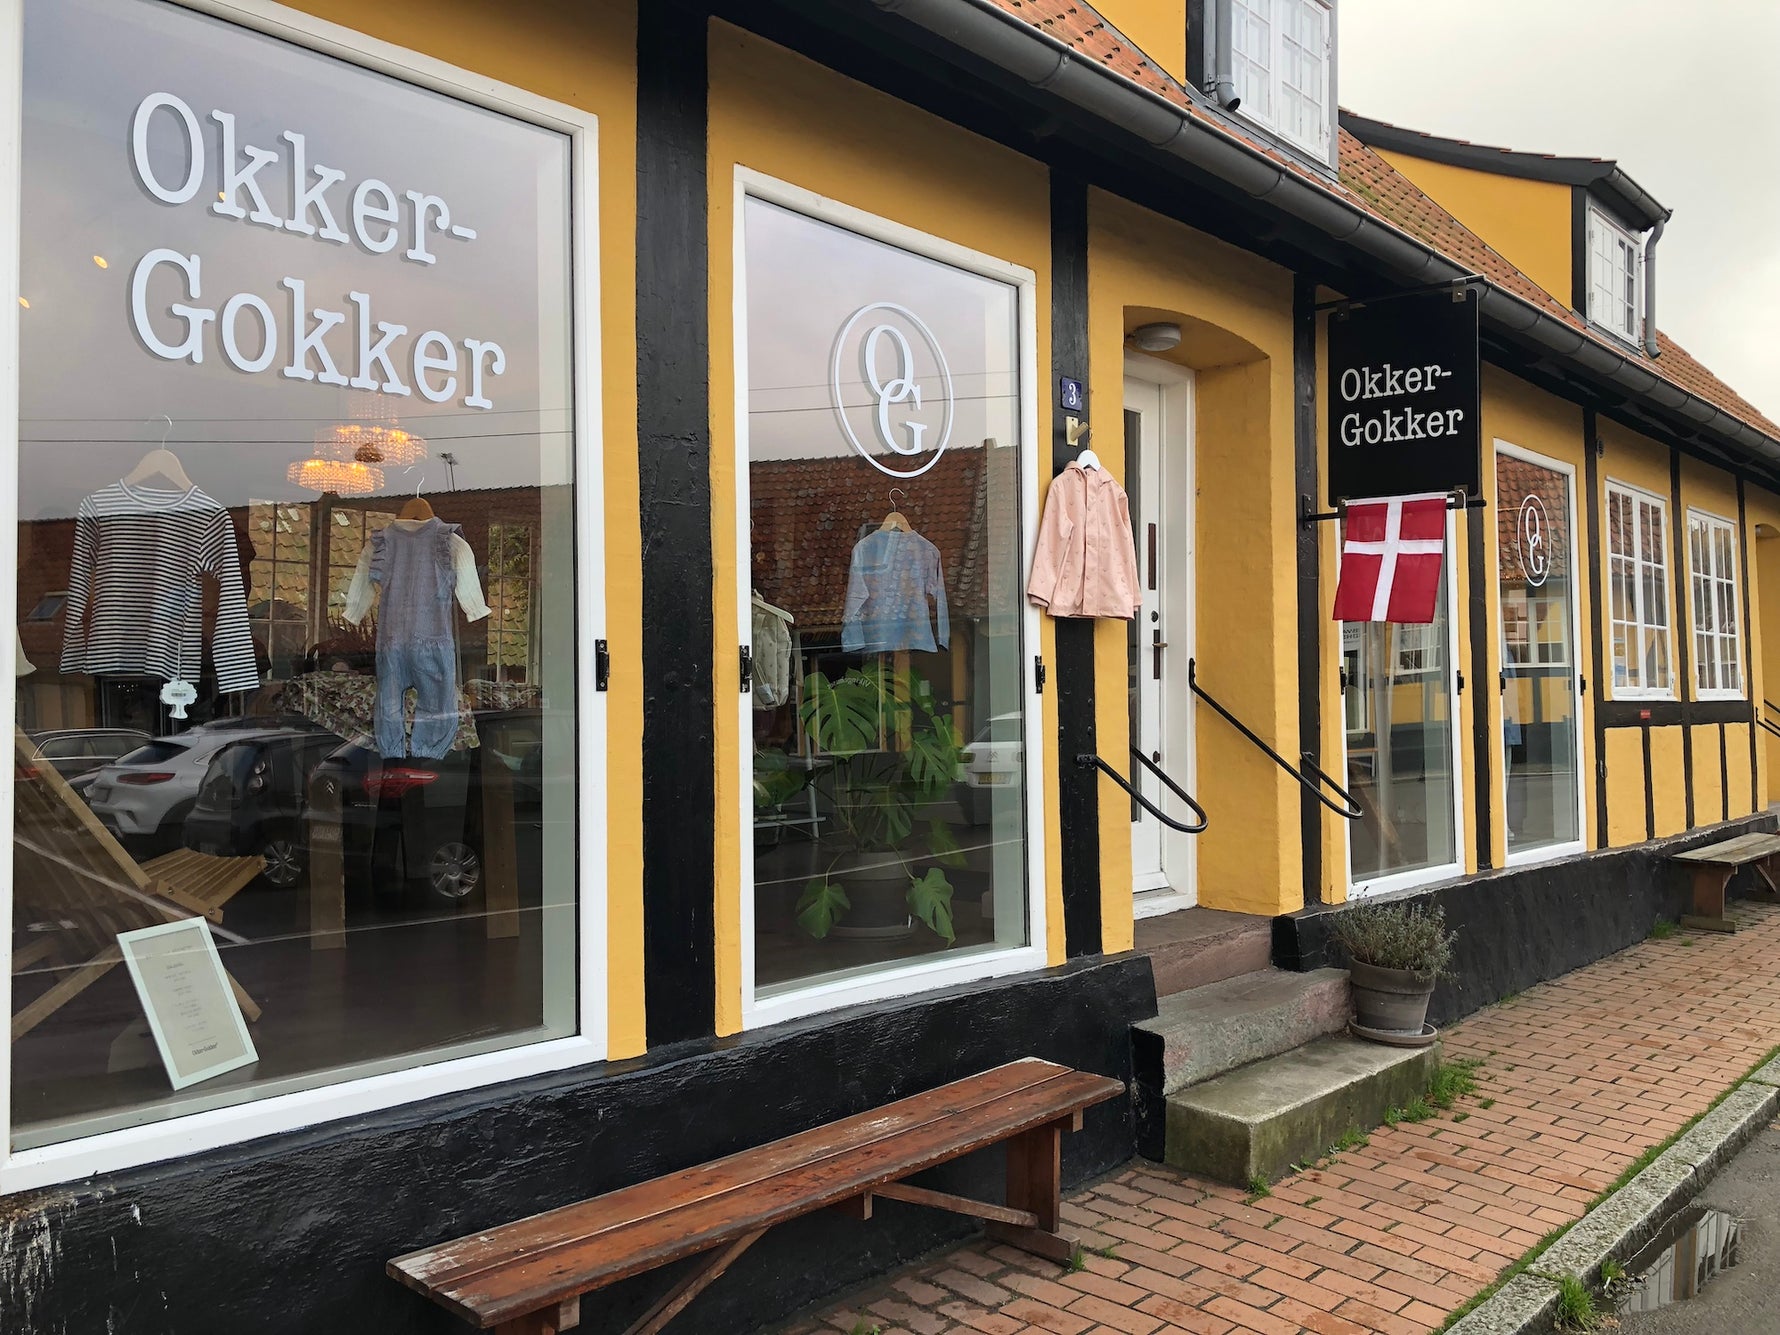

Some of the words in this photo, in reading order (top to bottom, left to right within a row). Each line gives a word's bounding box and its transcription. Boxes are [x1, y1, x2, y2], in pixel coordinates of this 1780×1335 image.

[132, 91, 478, 264] Okker-
[131, 248, 506, 410] Gokker
[1068, 383, 1077, 406] 3
[1340, 363, 1452, 402] Okker-
[1340, 406, 1464, 447] Gokker
